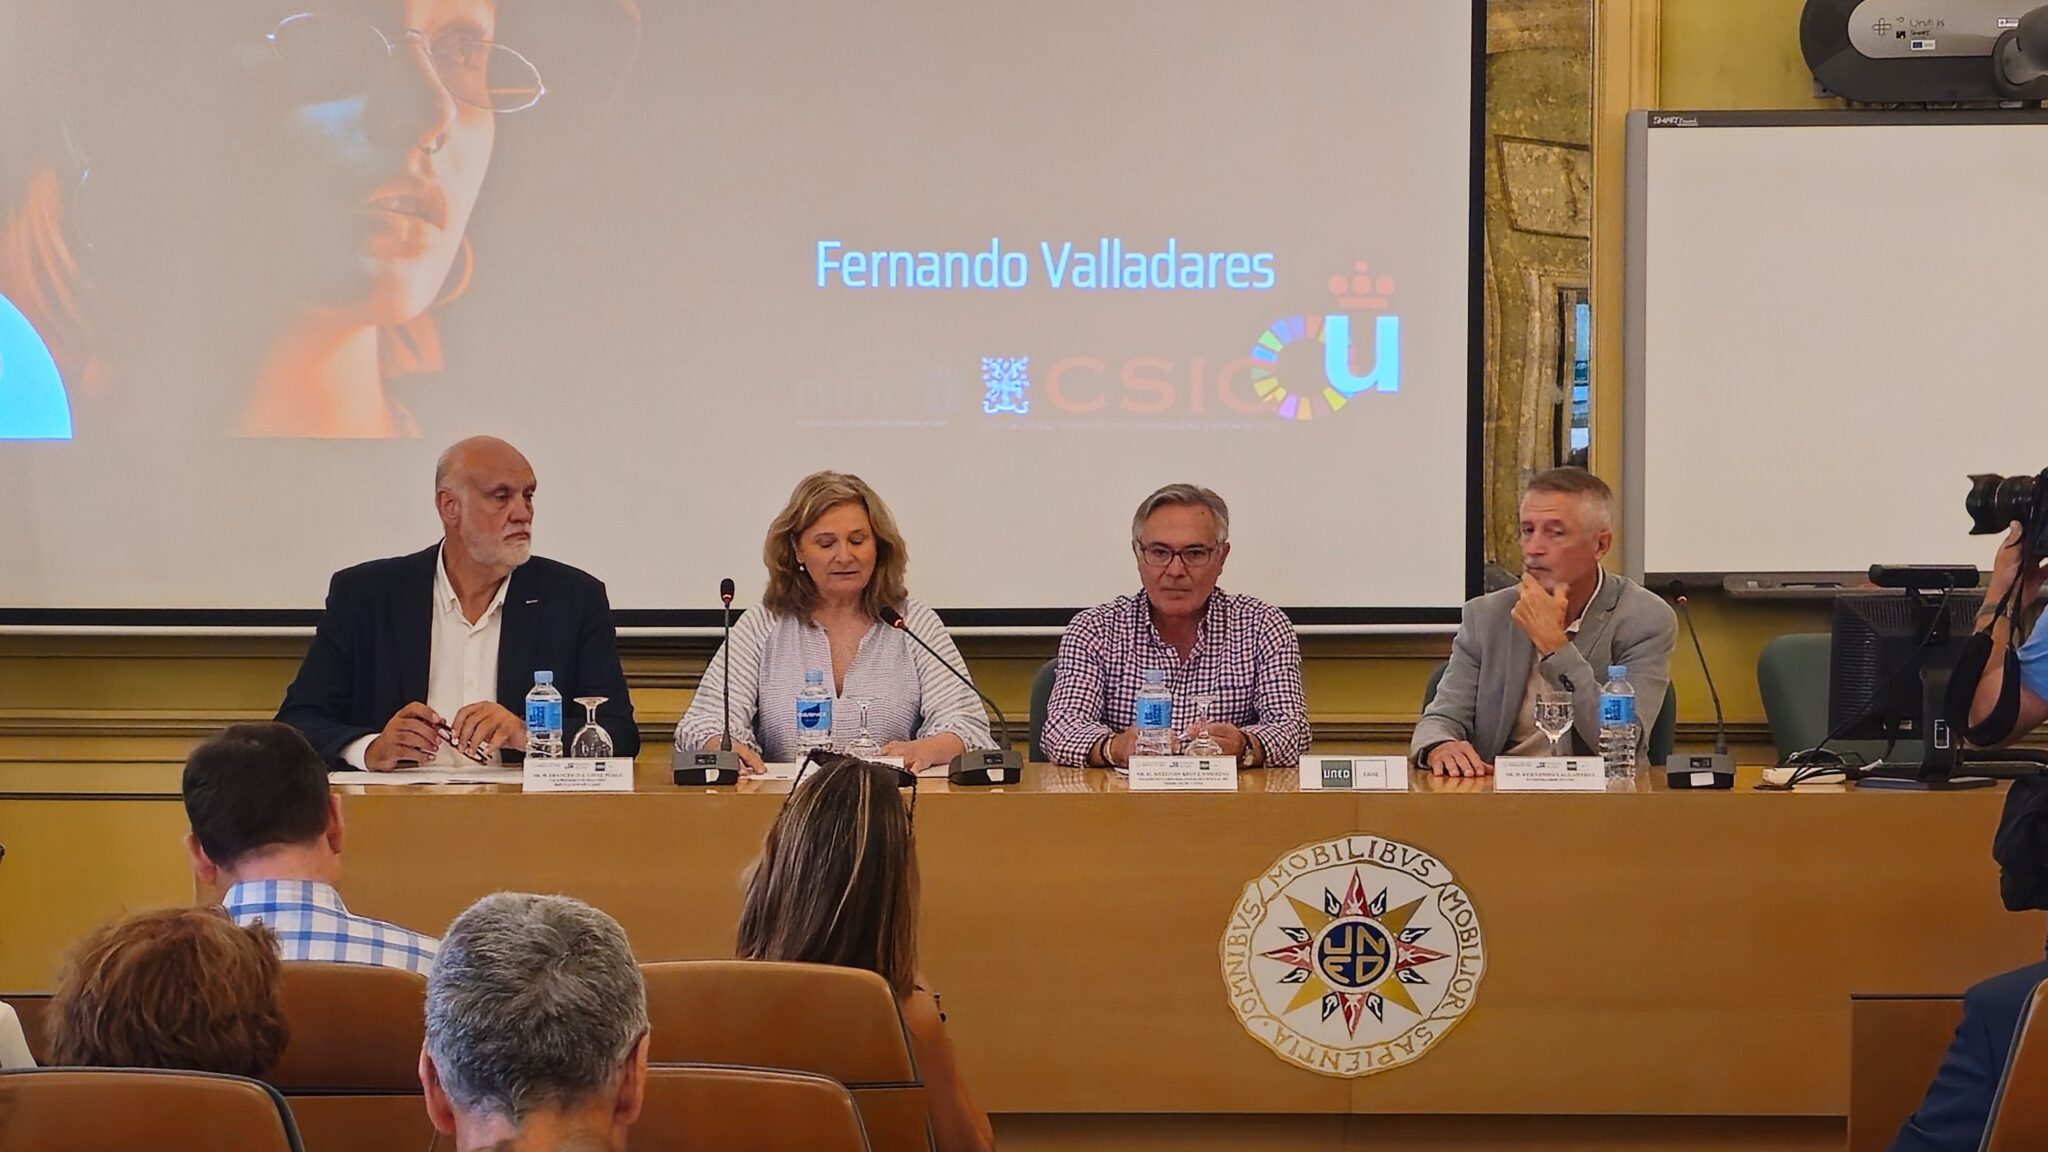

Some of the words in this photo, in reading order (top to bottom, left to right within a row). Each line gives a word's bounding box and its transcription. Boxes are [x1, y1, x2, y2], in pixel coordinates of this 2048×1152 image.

[815, 237, 1028, 289] Fernando
[1039, 237, 1277, 289] Valladares
[1045, 354, 1278, 414] CSIC
[1266, 837, 1436, 889] MOBILIBVS
[1227, 898, 1262, 1013] OMNIBVS
[1441, 888, 1482, 1011] MOBILIOR
[1272, 1026, 1434, 1073] SAPIENTIA
